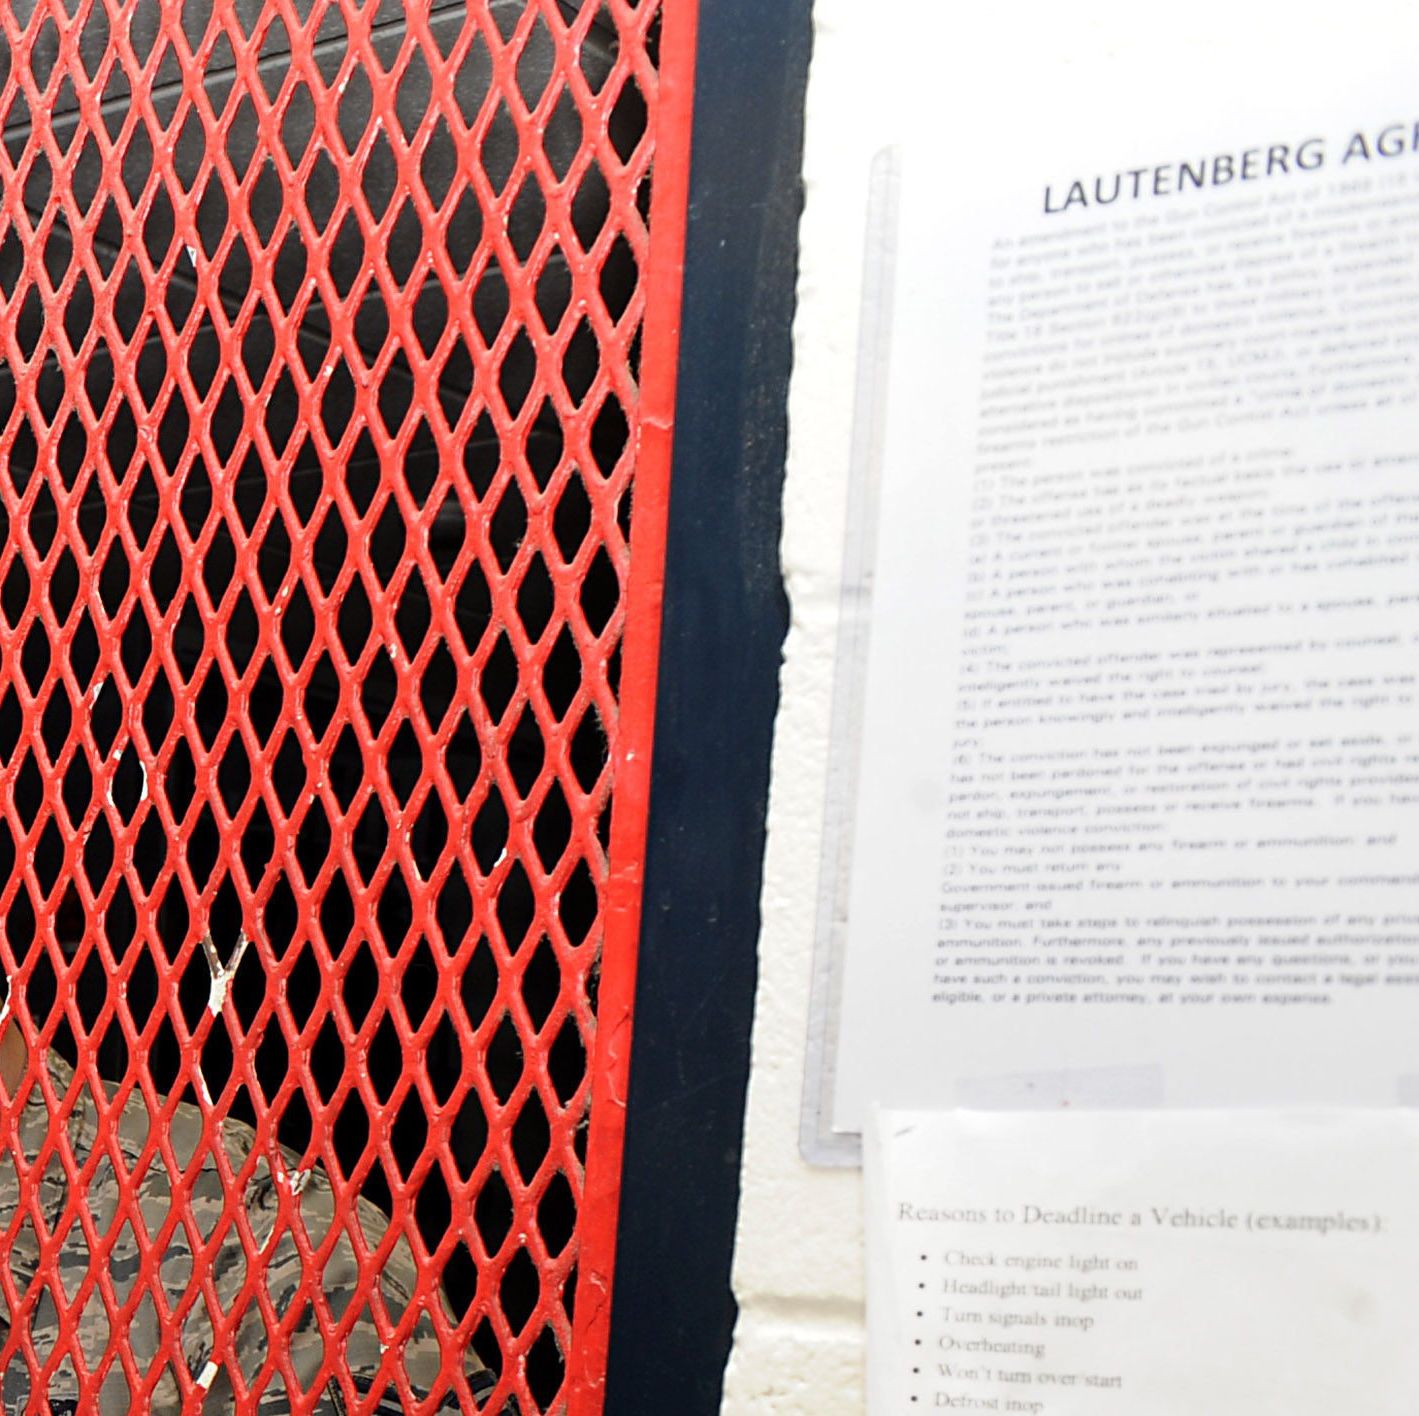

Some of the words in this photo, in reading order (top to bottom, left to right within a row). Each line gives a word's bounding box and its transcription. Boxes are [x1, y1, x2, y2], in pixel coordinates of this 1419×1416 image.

[1043, 138, 1324, 215] LAUTENBERG
[898, 1202, 987, 1224] Reasons
[994, 1208, 1015, 1223] to
[1021, 1205, 1123, 1226] Deadline
[1129, 1212, 1141, 1226] a
[1150, 1207, 1238, 1229] Vehicle
[944, 1251, 997, 1266] Check
[1005, 1257, 1062, 1271] engine
[1069, 1254, 1109, 1274] light
[1115, 1259, 1138, 1271] on
[1068, 1283, 1108, 1303] light
[1114, 1288, 1143, 1301] out
[945, 1307, 982, 1323] Turn
[989, 1312, 1047, 1328] signals
[1054, 1316, 1094, 1332] inop
[938, 1336, 1045, 1360] Overheating
[998, 1370, 1032, 1384] turn
[935, 1392, 998, 1409] Defrost
[1005, 1400, 1043, 1415] inop
